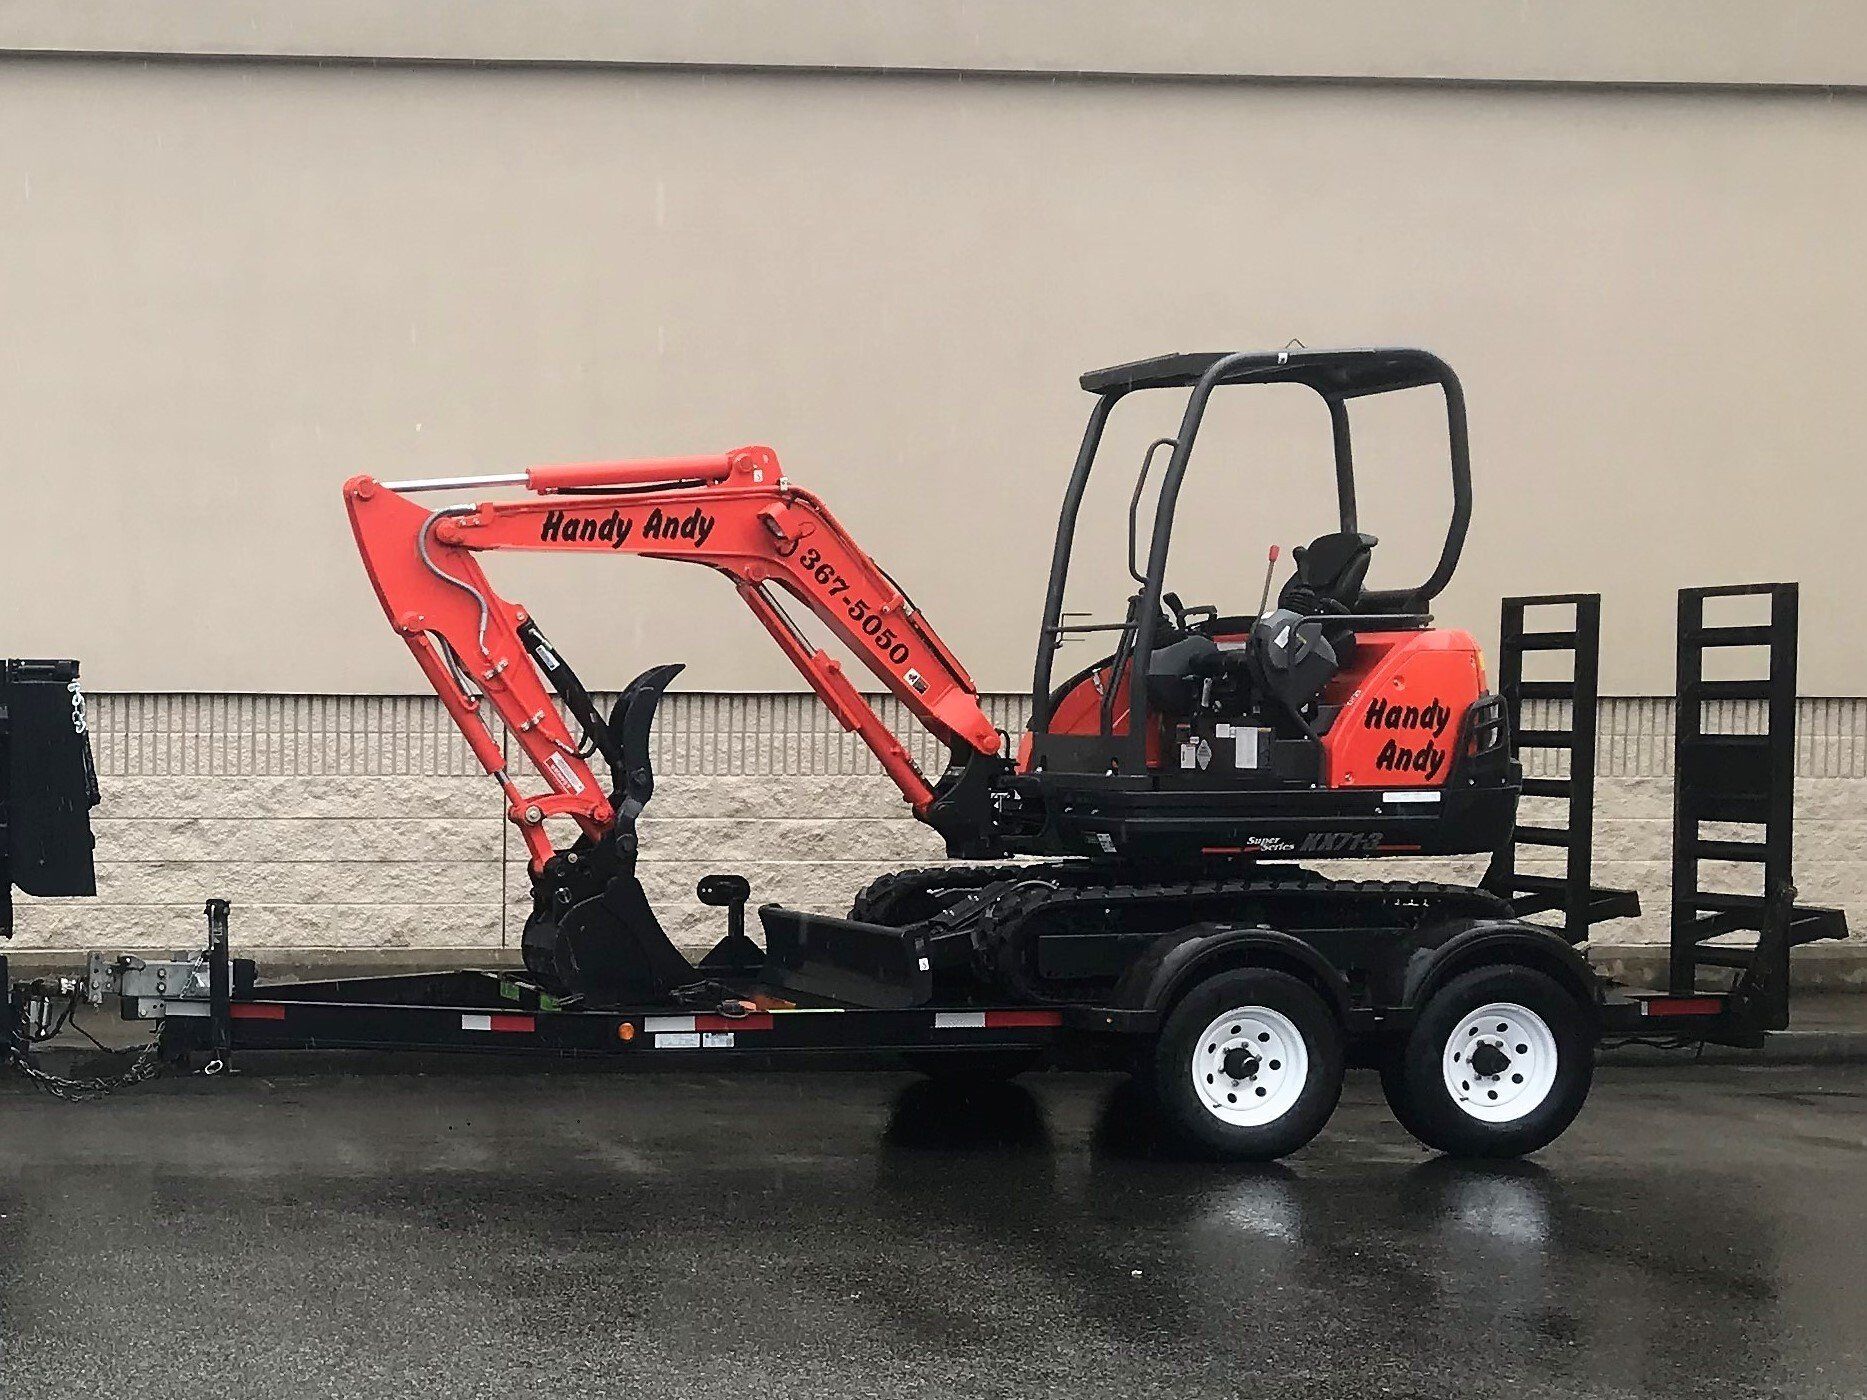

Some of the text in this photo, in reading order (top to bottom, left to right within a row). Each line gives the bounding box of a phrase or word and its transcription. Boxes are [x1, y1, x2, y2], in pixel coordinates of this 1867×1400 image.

[540, 507, 715, 549] Handy Andy
[800, 548, 909, 664] 367-5050
[1364, 697, 1451, 738] Handy
[1376, 738, 1446, 781] Andy
[1246, 836, 1281, 847] Super
[1260, 842, 1295, 851] Series
